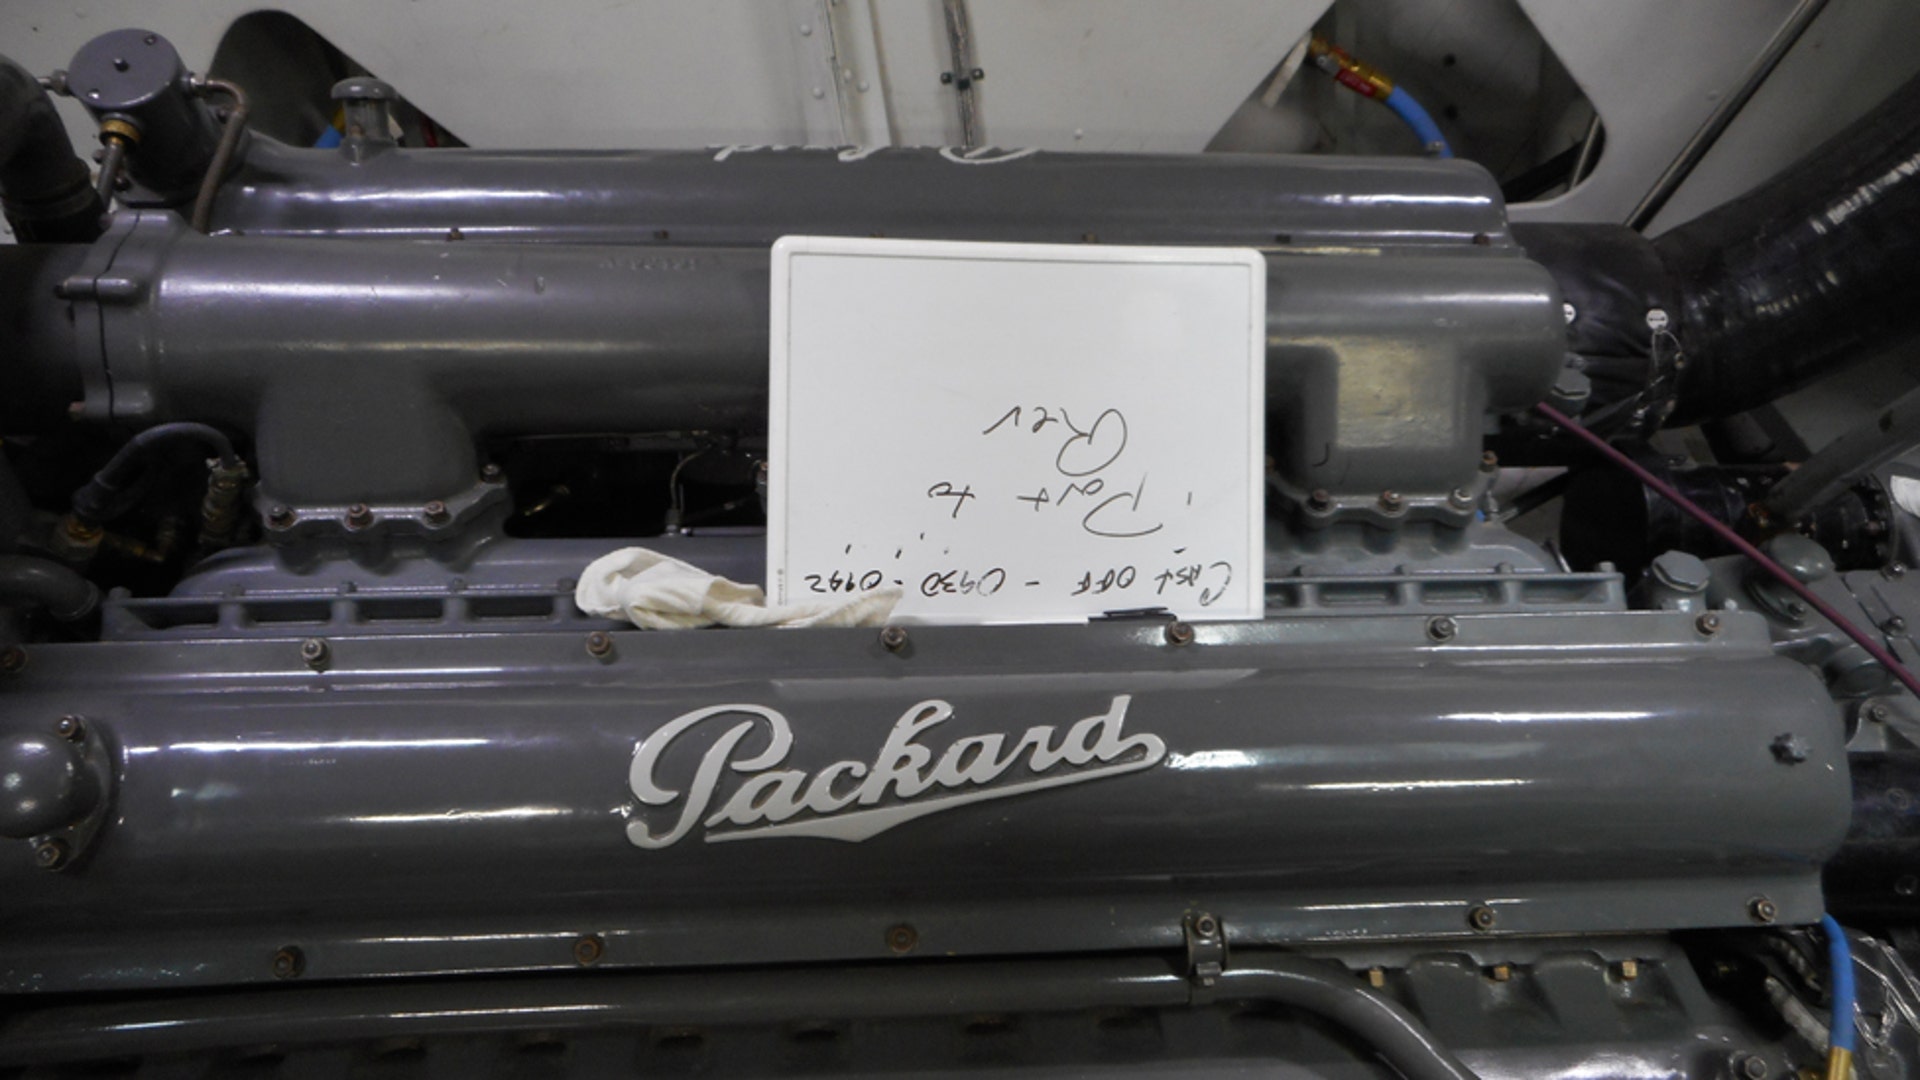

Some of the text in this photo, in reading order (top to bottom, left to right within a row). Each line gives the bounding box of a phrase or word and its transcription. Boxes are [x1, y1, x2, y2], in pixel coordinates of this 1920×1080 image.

[982, 405, 1127, 477] Rev
[927, 473, 1163, 538] Port to
[920, 568, 1006, 597] 0930
[626, 694, 1167, 850] Packard
